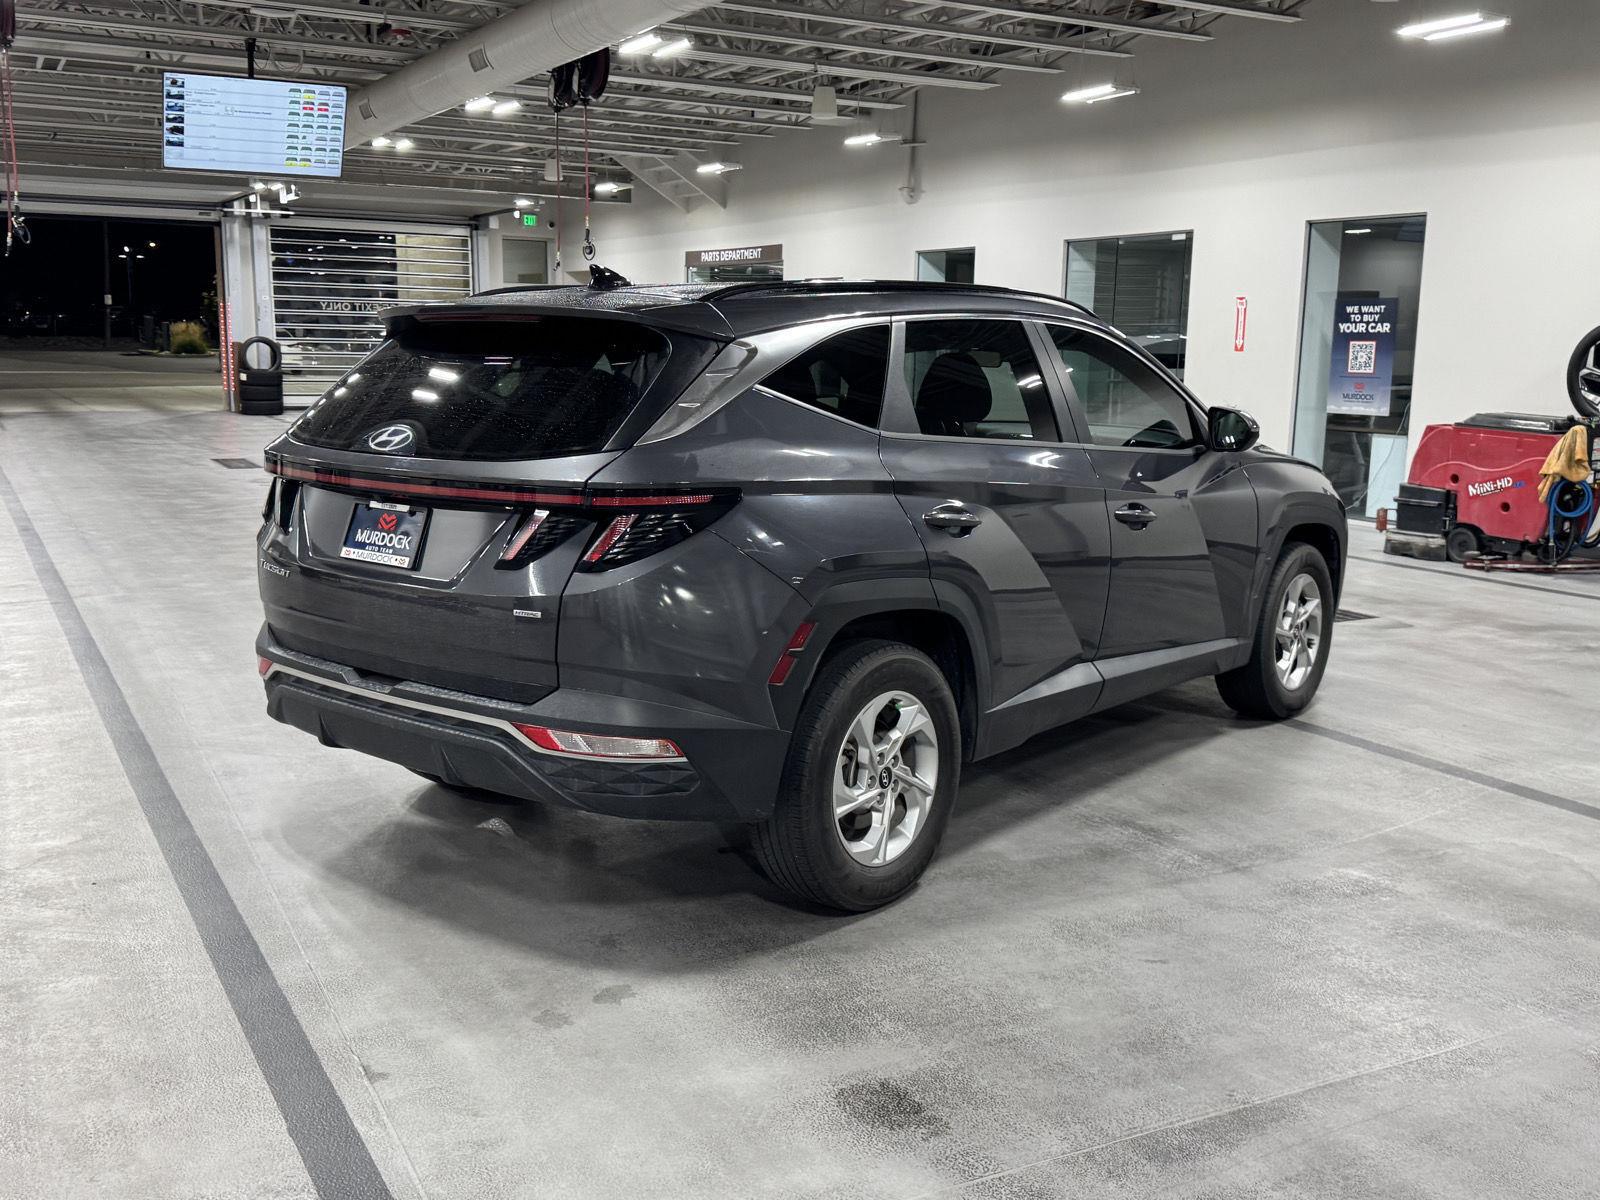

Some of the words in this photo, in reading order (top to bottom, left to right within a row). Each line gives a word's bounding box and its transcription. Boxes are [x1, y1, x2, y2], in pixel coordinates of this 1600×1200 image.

[524, 214, 537, 226] EXIT
[701, 251, 720, 262] PARTS
[720, 248, 762, 261] DEPARTMENT
[1361, 305, 1386, 313] WANT
[1363, 314, 1380, 322] BUY
[1339, 323, 1366, 333] YOUR
[1368, 323, 1391, 333] CAR
[1342, 393, 1374, 401] MURDOCK
[355, 528, 412, 550] MURDOCK
[379, 546, 393, 554] TEAM
[355, 551, 393, 563] MURDOCK
